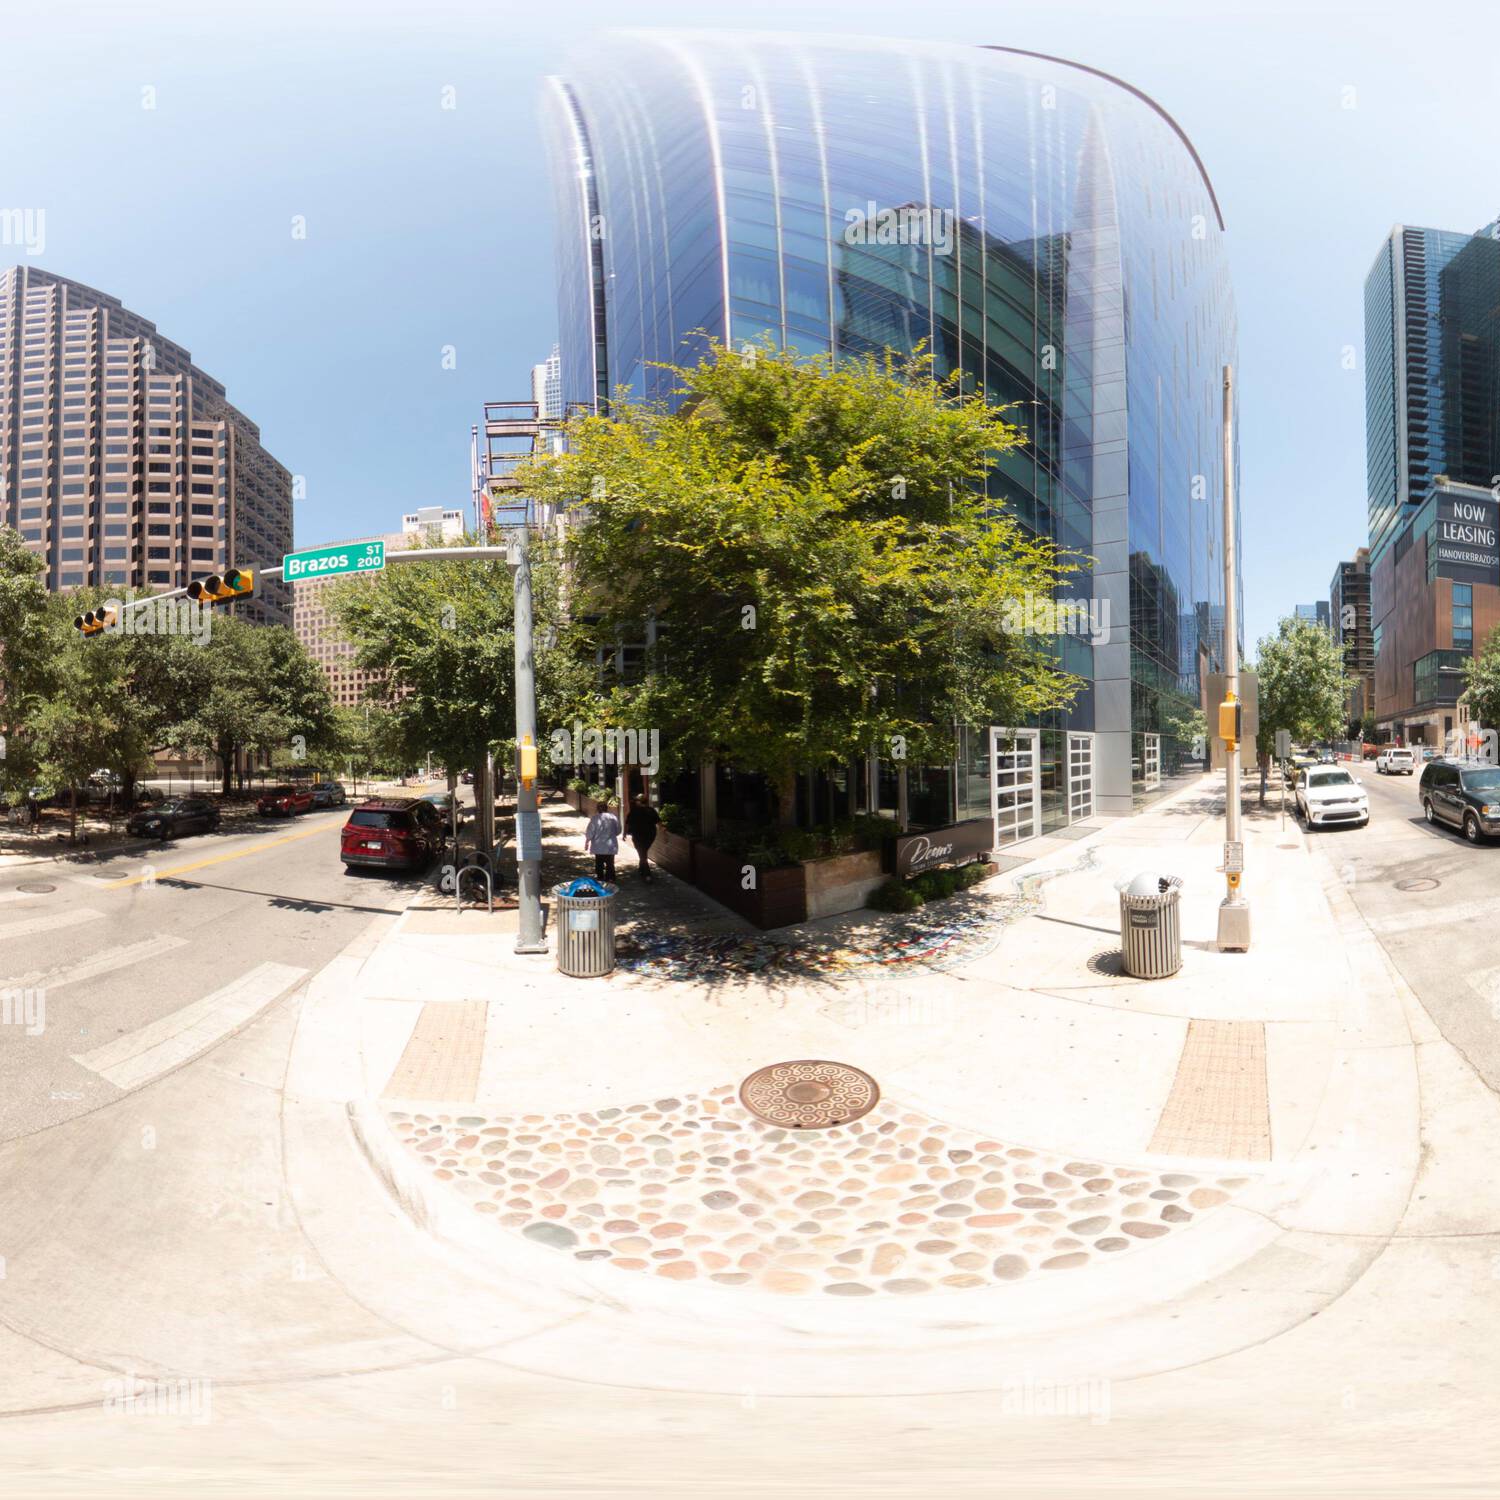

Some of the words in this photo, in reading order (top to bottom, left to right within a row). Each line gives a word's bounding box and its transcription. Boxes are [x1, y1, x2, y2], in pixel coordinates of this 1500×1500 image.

[1453, 502, 1486, 522] NOW
[1443, 522, 1495, 546] LEASING
[366, 544, 381, 555] ST
[289, 554, 348, 575] Brazos
[357, 556, 381, 568] 200
